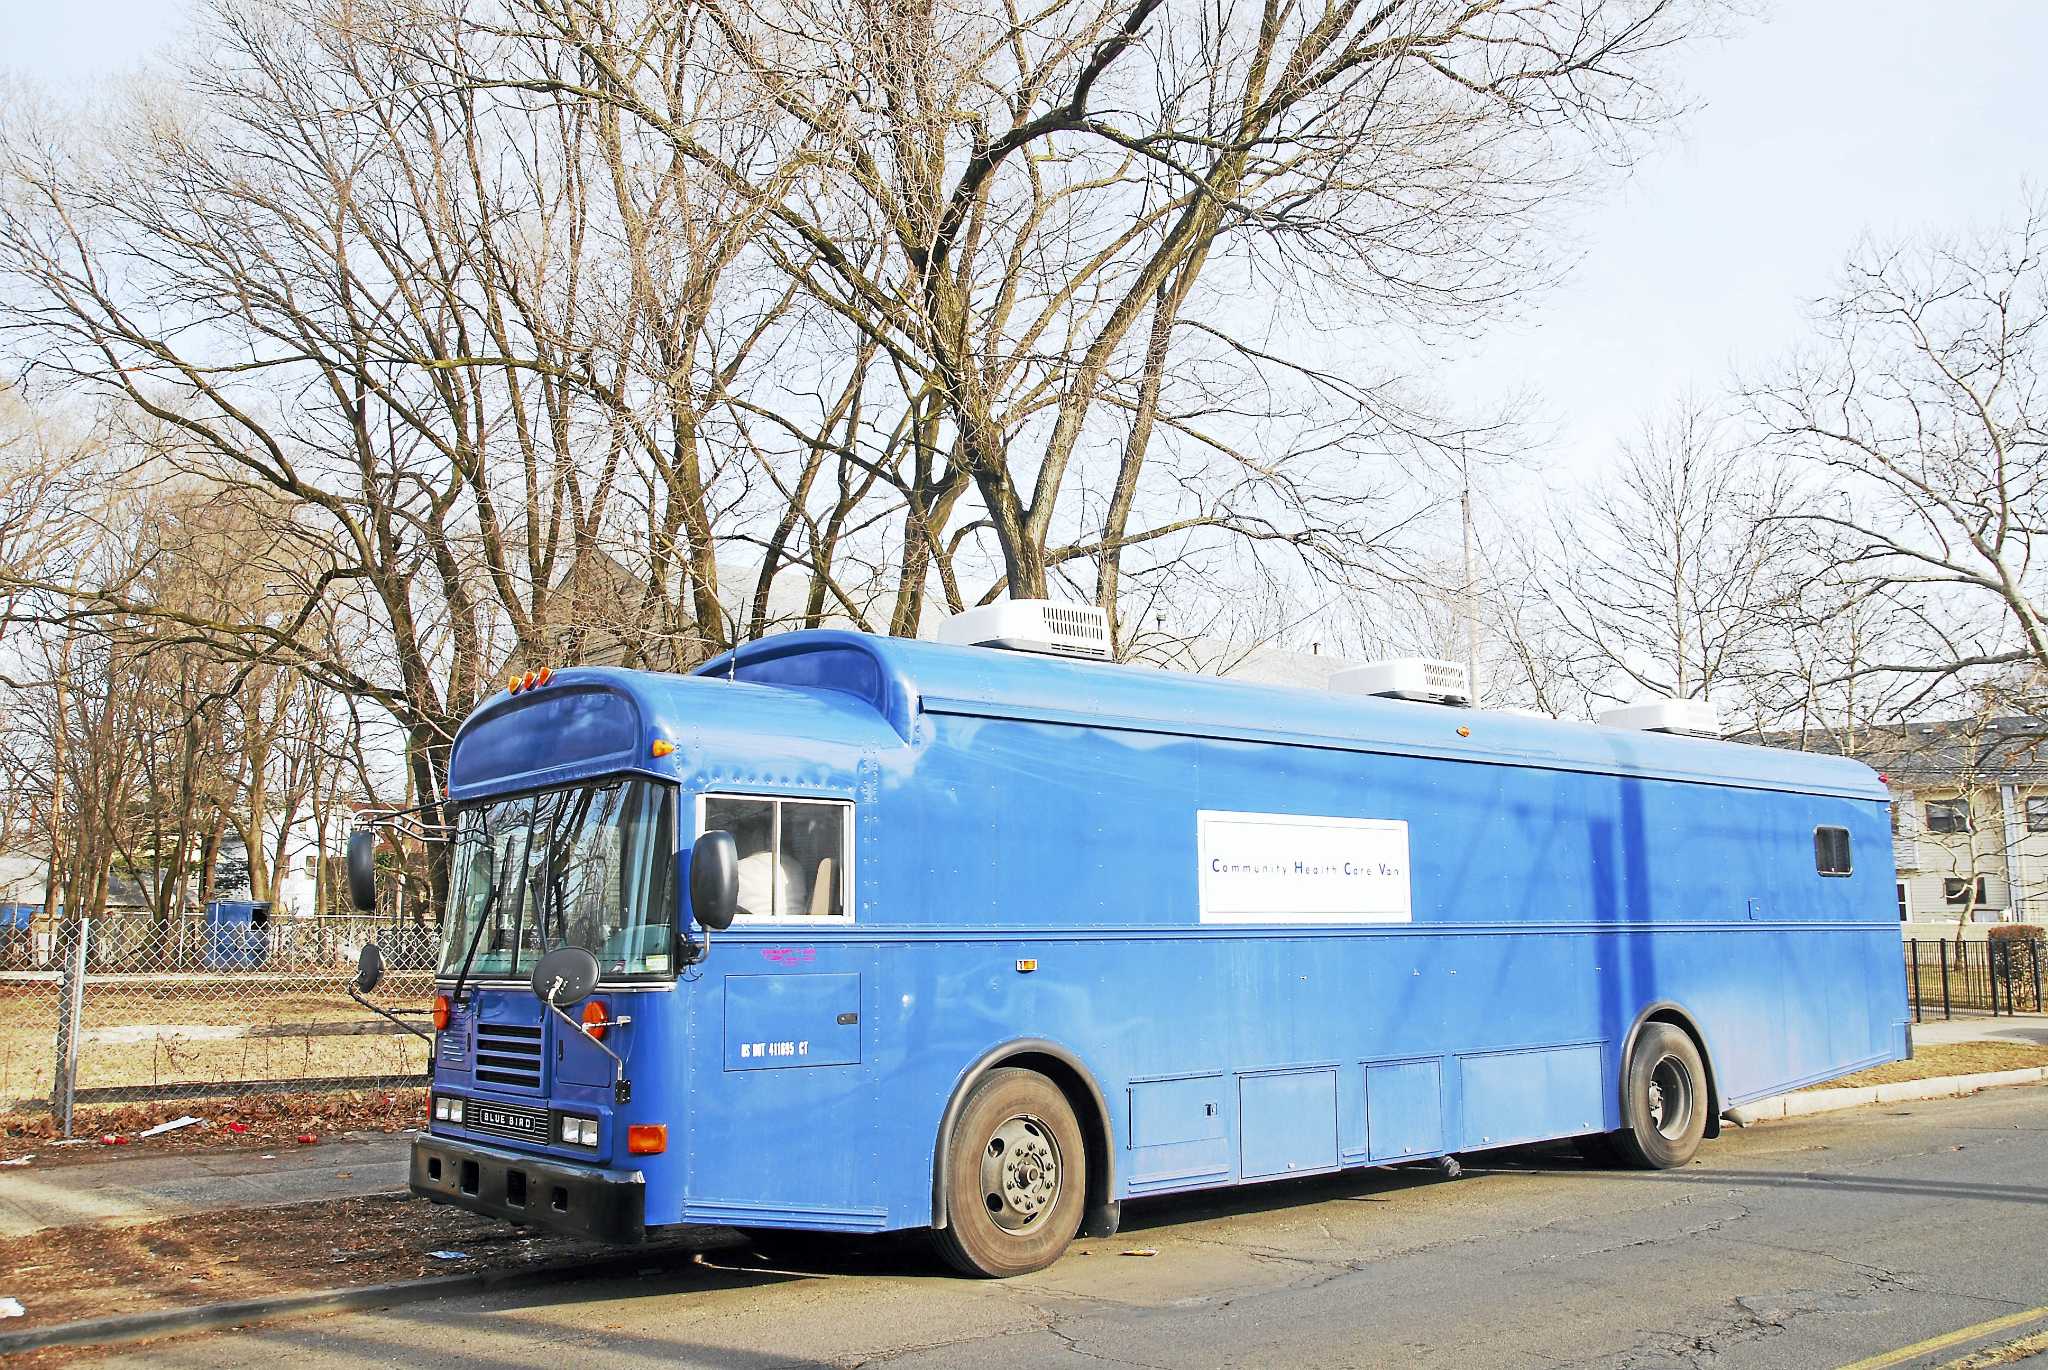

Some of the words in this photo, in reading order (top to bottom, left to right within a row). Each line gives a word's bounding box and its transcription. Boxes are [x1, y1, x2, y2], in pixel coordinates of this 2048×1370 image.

[1212, 858, 1287, 875] Community
[1294, 861, 1337, 875] Health
[1344, 862, 1372, 876] Care
[1378, 863, 1400, 876] Van
[741, 1043, 750, 1057] US
[753, 1043, 765, 1057] DOT
[799, 1041, 808, 1055] CT
[485, 1113, 505, 1124] BLUE
[509, 1117, 531, 1128] BIRD
